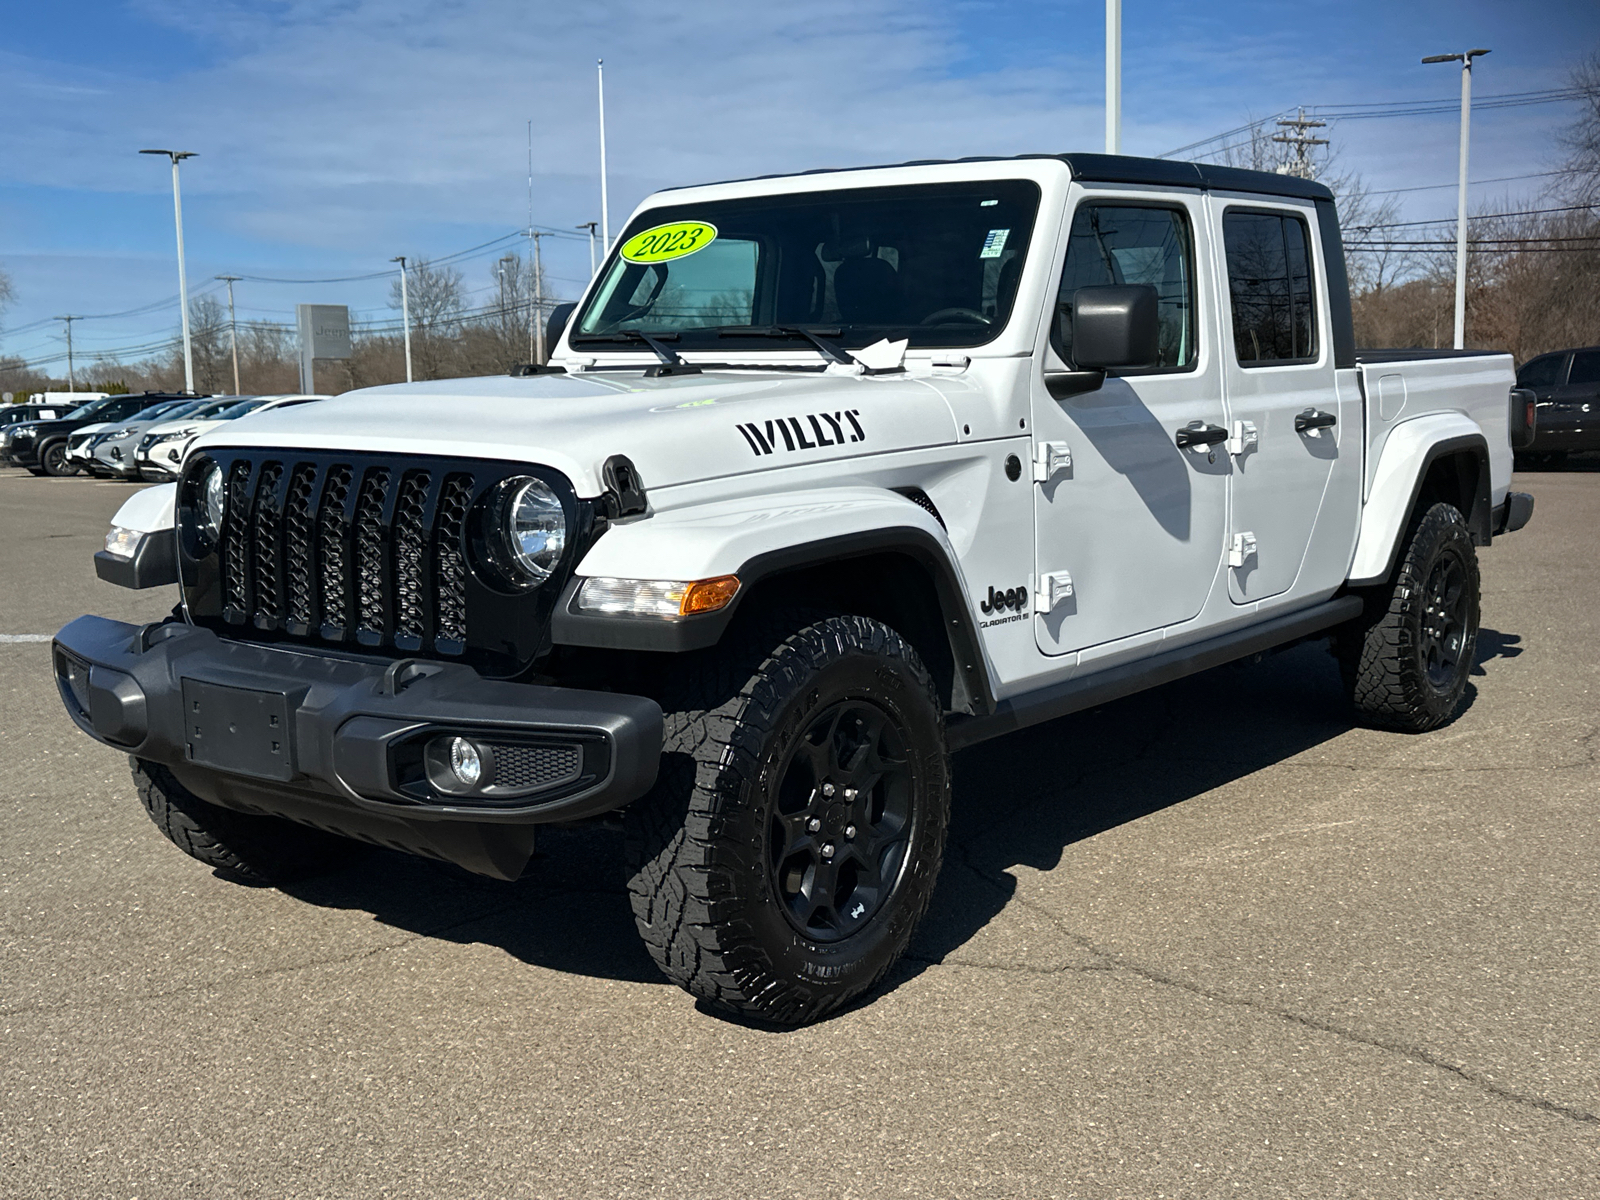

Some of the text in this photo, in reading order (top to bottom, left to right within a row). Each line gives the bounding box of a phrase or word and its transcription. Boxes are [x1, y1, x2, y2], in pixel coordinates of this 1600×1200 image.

[632, 228, 704, 257] 2023
[315, 325, 347, 338] Jeep
[735, 409, 866, 456] WILLYS
[980, 585, 1028, 614] Jeep
[979, 614, 1022, 629] GLADIATOR
